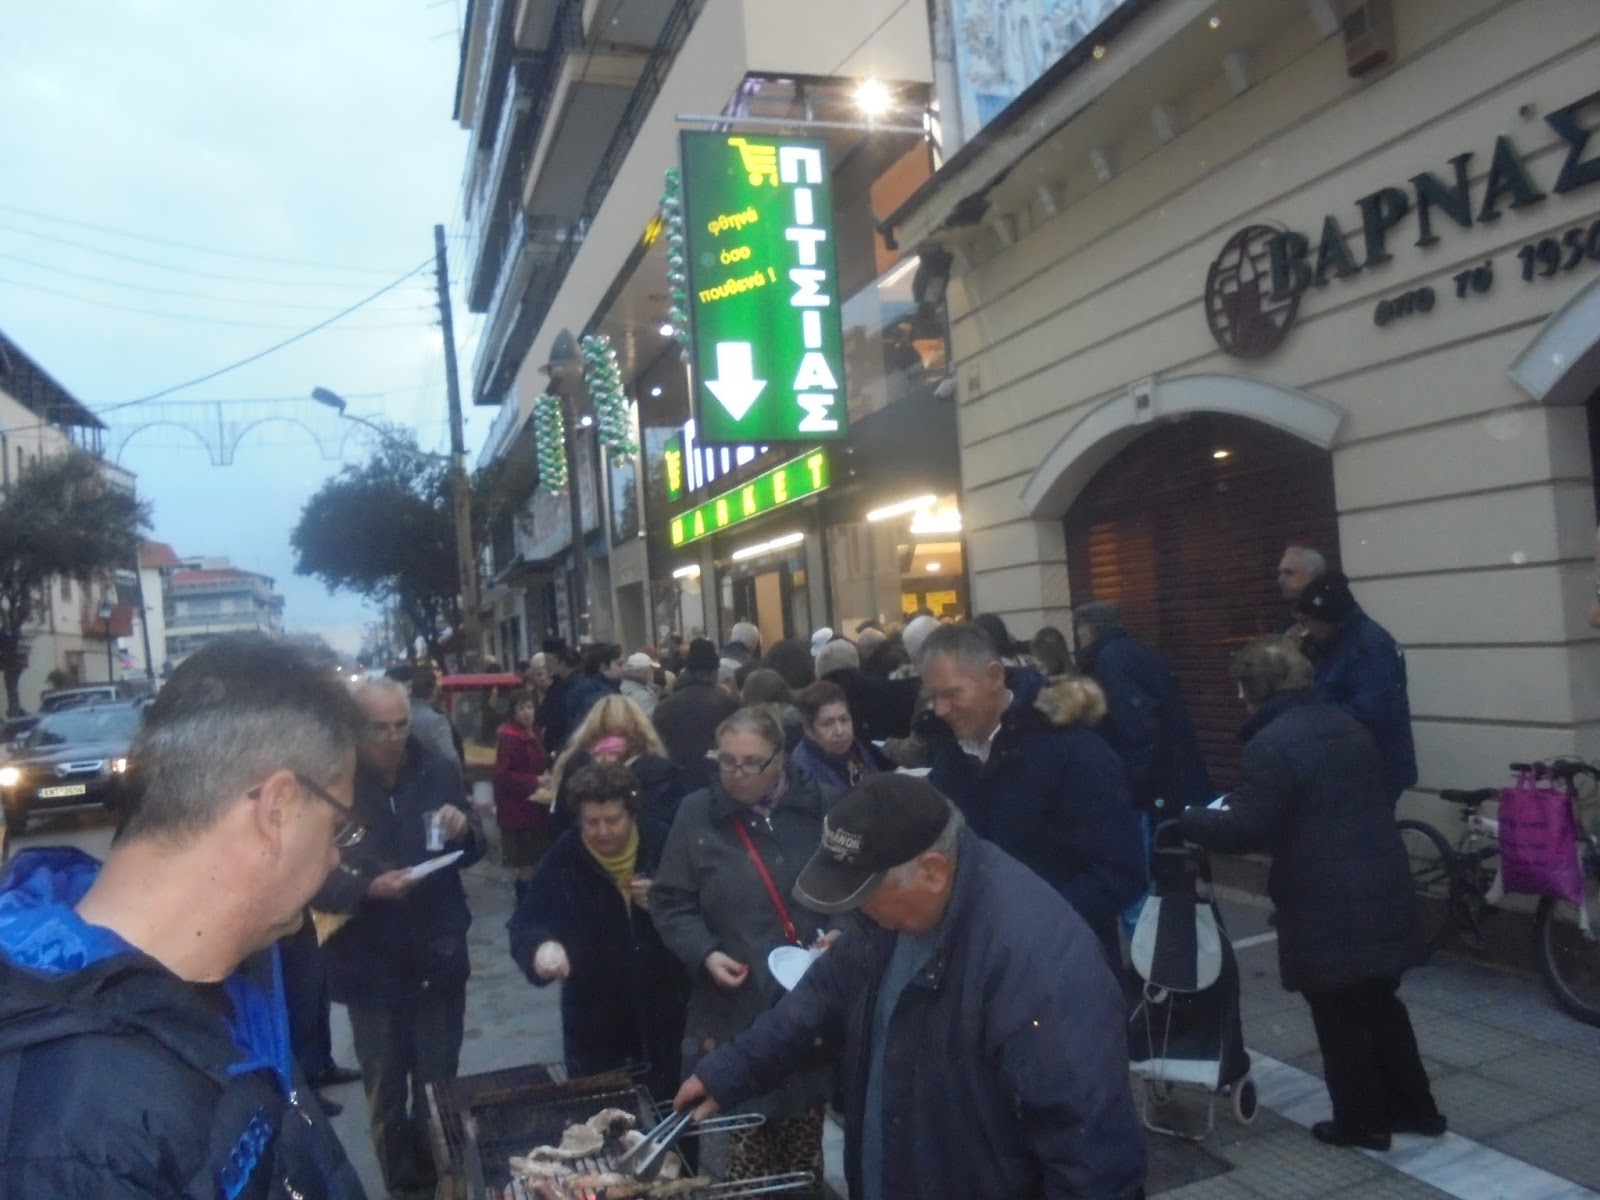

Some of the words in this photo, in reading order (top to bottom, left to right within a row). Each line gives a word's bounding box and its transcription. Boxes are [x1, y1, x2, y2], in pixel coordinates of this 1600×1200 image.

[707, 206, 758, 237] φθηνά
[719, 246, 751, 265] όσο
[698, 270, 766, 304] πουθενά
[779, 146, 839, 432] ΠΙΤΣΙΑΣ
